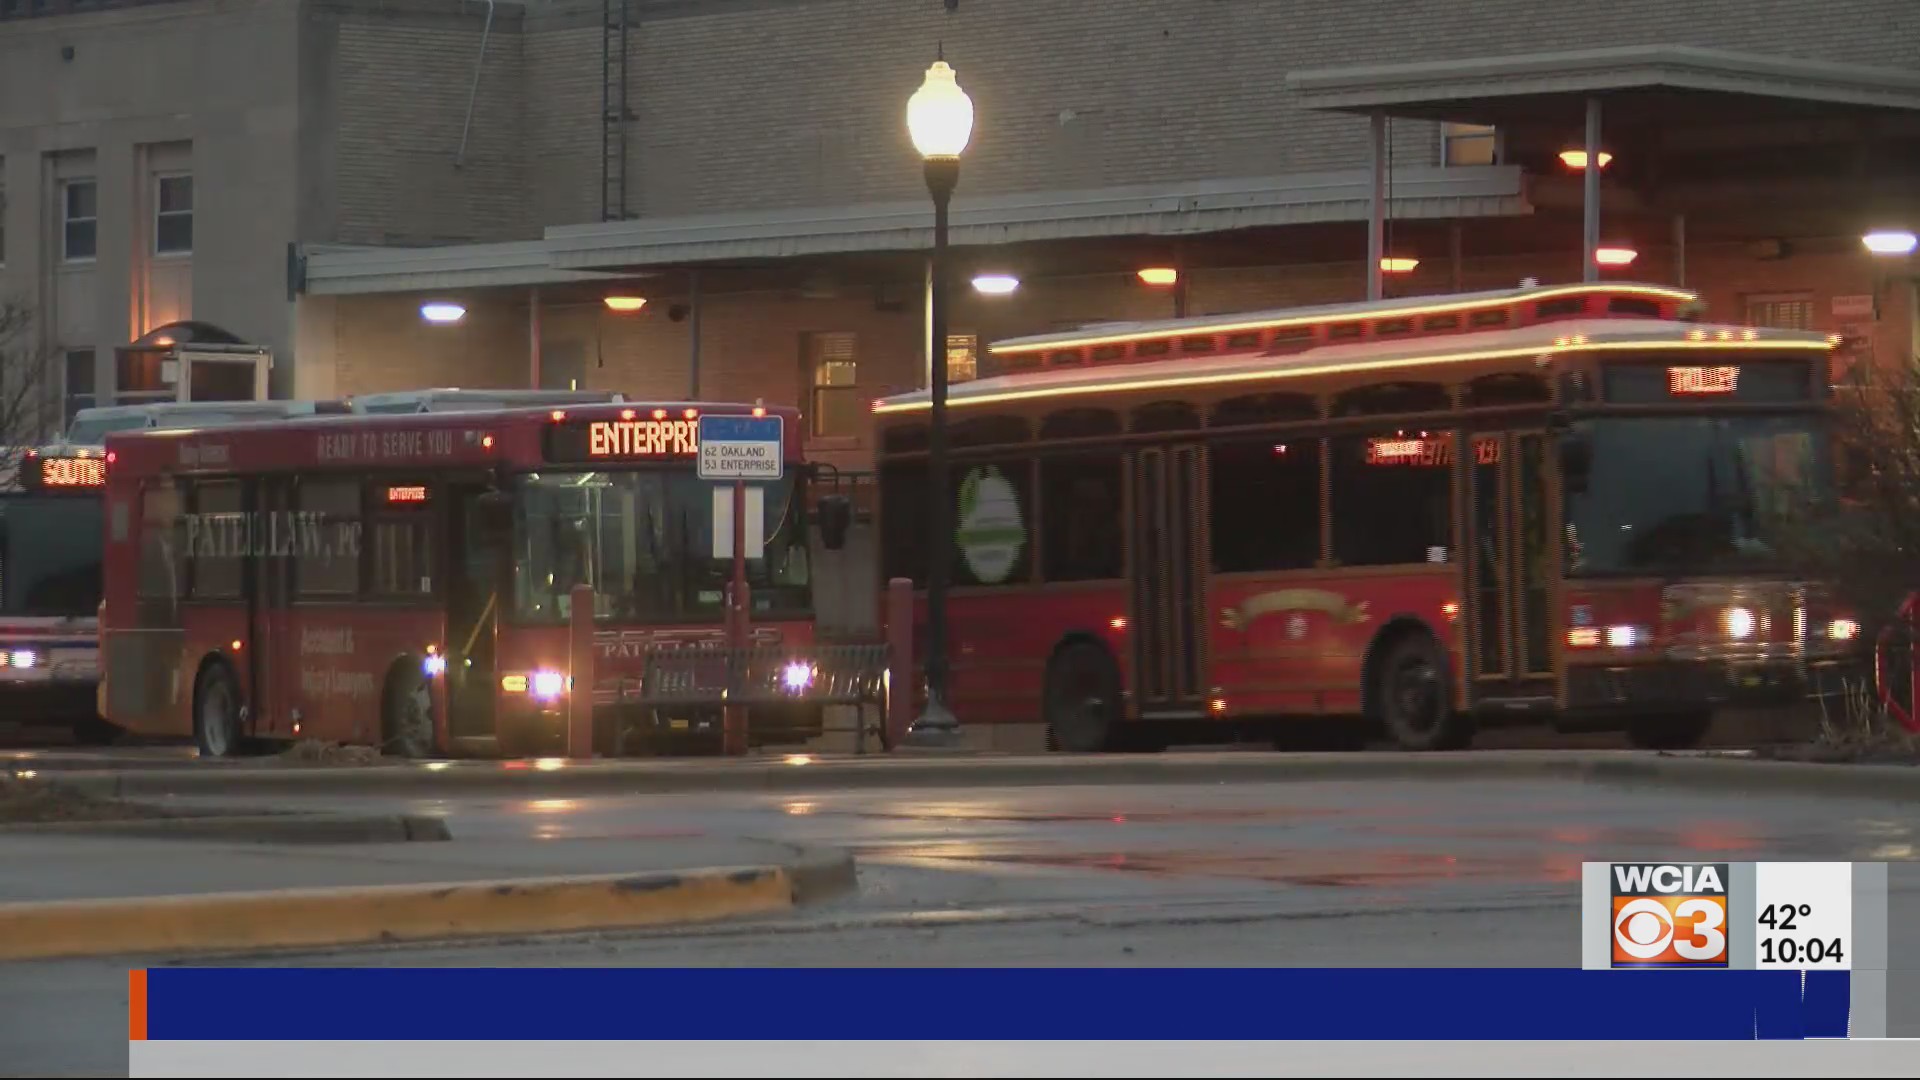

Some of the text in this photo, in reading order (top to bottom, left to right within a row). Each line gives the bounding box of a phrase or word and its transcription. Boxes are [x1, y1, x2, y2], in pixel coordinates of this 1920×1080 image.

[317, 431, 452, 458] READY TO SERVE YOU
[591, 421, 698, 454] ENTERPRI
[704, 446, 766, 457] 62 OAKLAND
[704, 459, 777, 471] 53 ENTERPRISE
